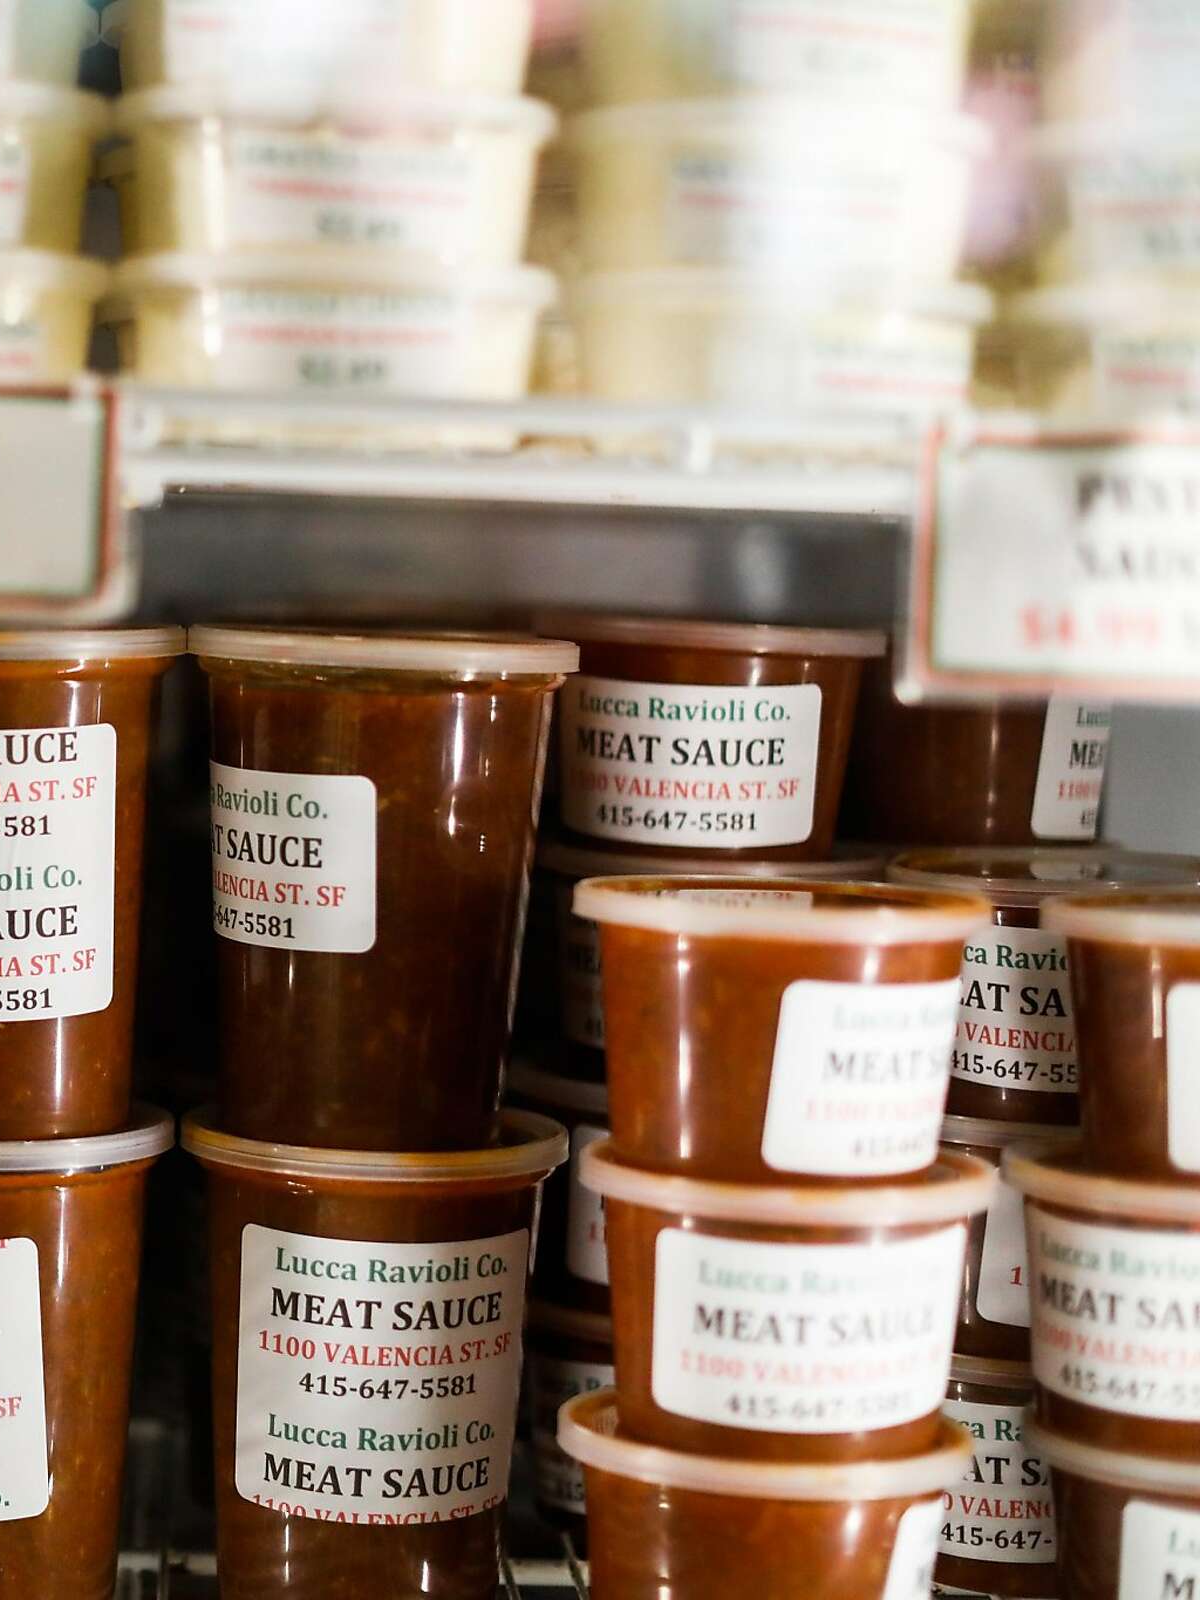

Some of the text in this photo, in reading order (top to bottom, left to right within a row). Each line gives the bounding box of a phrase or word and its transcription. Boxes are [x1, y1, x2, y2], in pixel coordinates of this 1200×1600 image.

[579, 690, 791, 722] Lucca Ravioli Co.
[577, 727, 785, 767] MEAT SAUCE
[28, 779, 66, 802] ST.
[72, 776, 97, 799] SF
[217, 783, 328, 819] Ravioli Co.
[614, 775, 731, 801] VALENCIA
[739, 781, 772, 801] ST.
[777, 778, 800, 799] SF
[596, 803, 757, 833] 415-647-5581
[227, 828, 323, 869] SAUCE
[43, 864, 83, 889] Co.
[274, 882, 309, 906] ST.
[316, 885, 346, 907] SF
[30, 953, 67, 977] ST.
[72, 947, 97, 972] SF
[960, 980, 1010, 1012] AT
[823, 1048, 923, 1085] MEAT
[275, 1247, 507, 1284] Lucca Ravioli Co.
[698, 1258, 789, 1292] Lucca
[270, 1287, 502, 1331] MEAT SAUCE
[1040, 1272, 1123, 1325] MEAT
[692, 1302, 815, 1345] MEAT
[258, 1329, 512, 1367] 1100 VALENCIA ST. SF
[299, 1372, 477, 1400] 415-647-5581
[267, 1413, 495, 1452] Lucca Ravioli Co.
[263, 1452, 490, 1499] MEAT SAUCE
